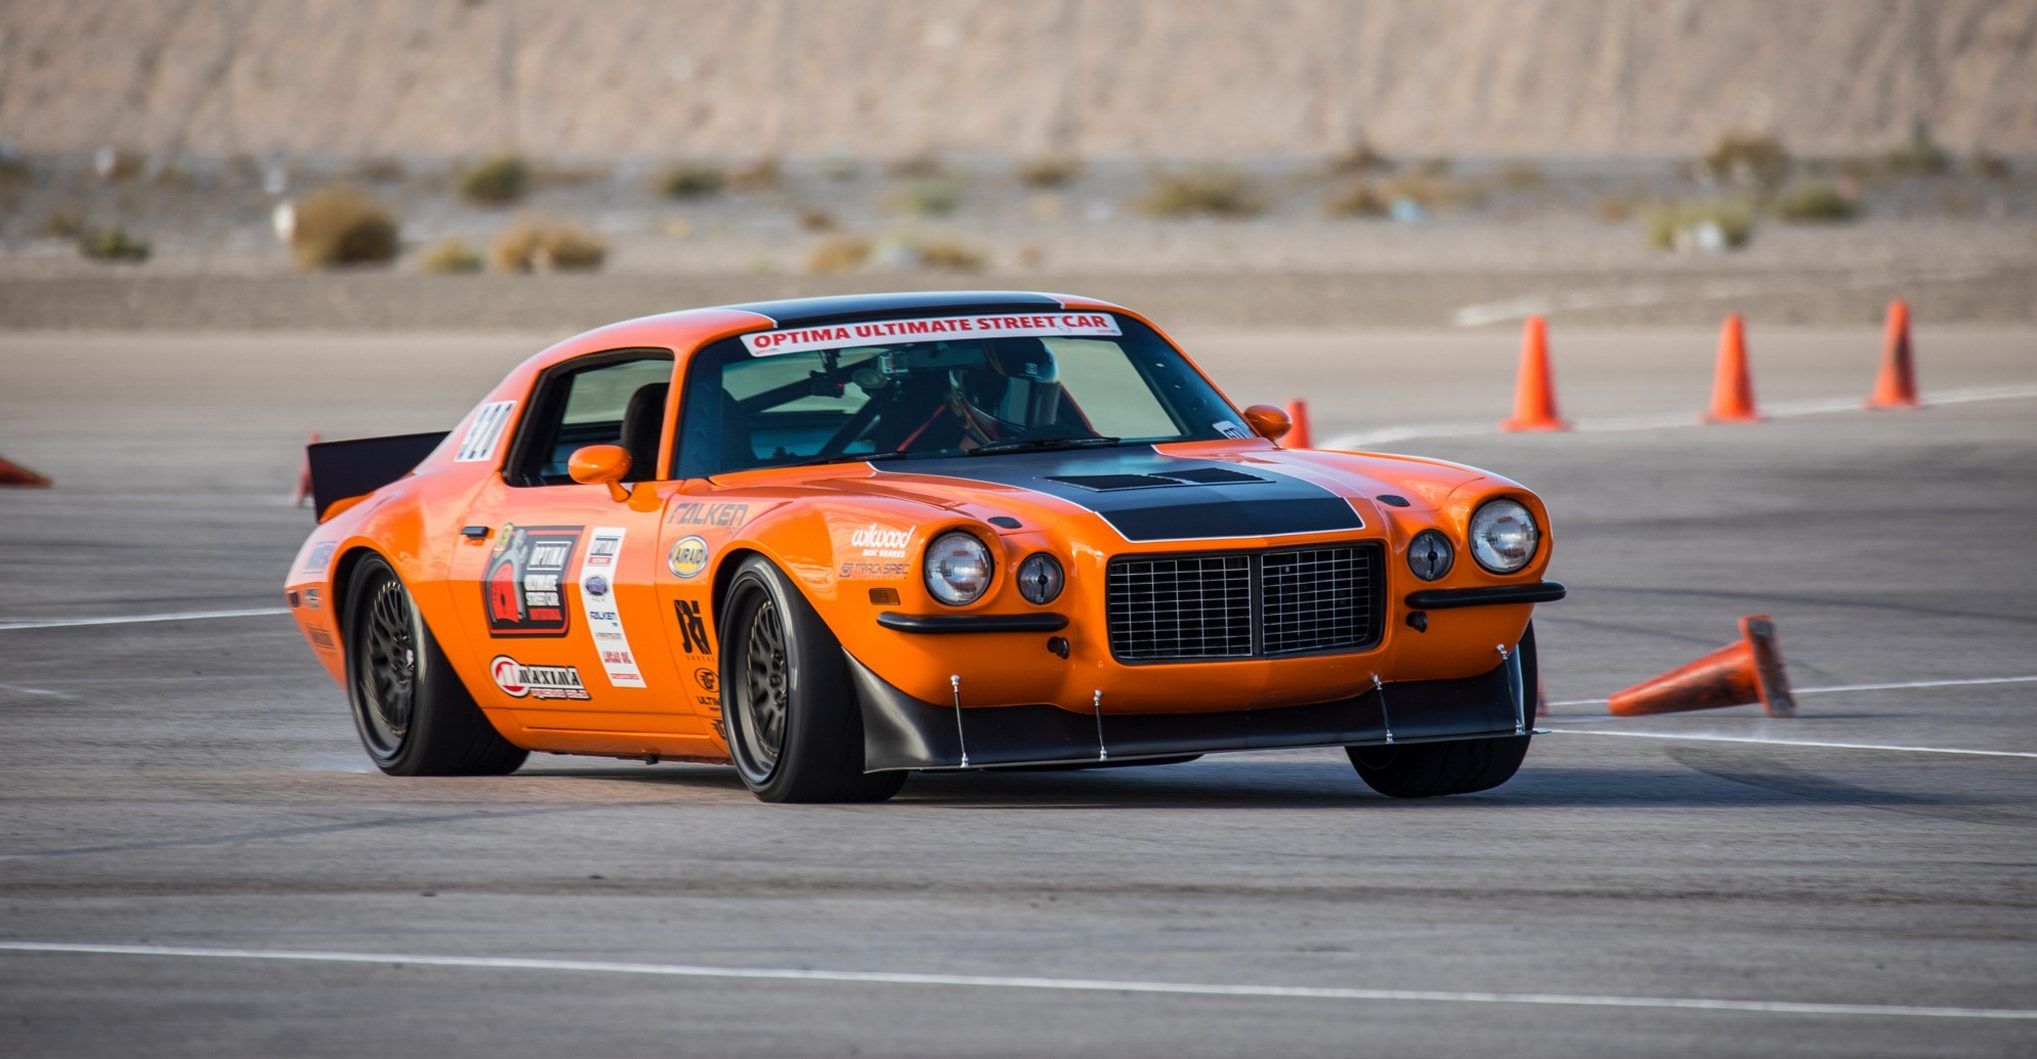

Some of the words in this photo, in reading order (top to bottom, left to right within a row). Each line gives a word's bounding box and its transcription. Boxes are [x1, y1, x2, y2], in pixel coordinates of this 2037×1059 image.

[754, 327, 851, 348] OPTIMA
[855, 319, 973, 338] ULTIMATE
[976, 316, 1056, 330] STREET
[1061, 315, 1108, 328] CAR
[668, 503, 749, 526] FALKEN
[851, 523, 916, 549] wilwood
[674, 547, 705, 564] AIRAID
[518, 669, 581, 686] MAXIMA
